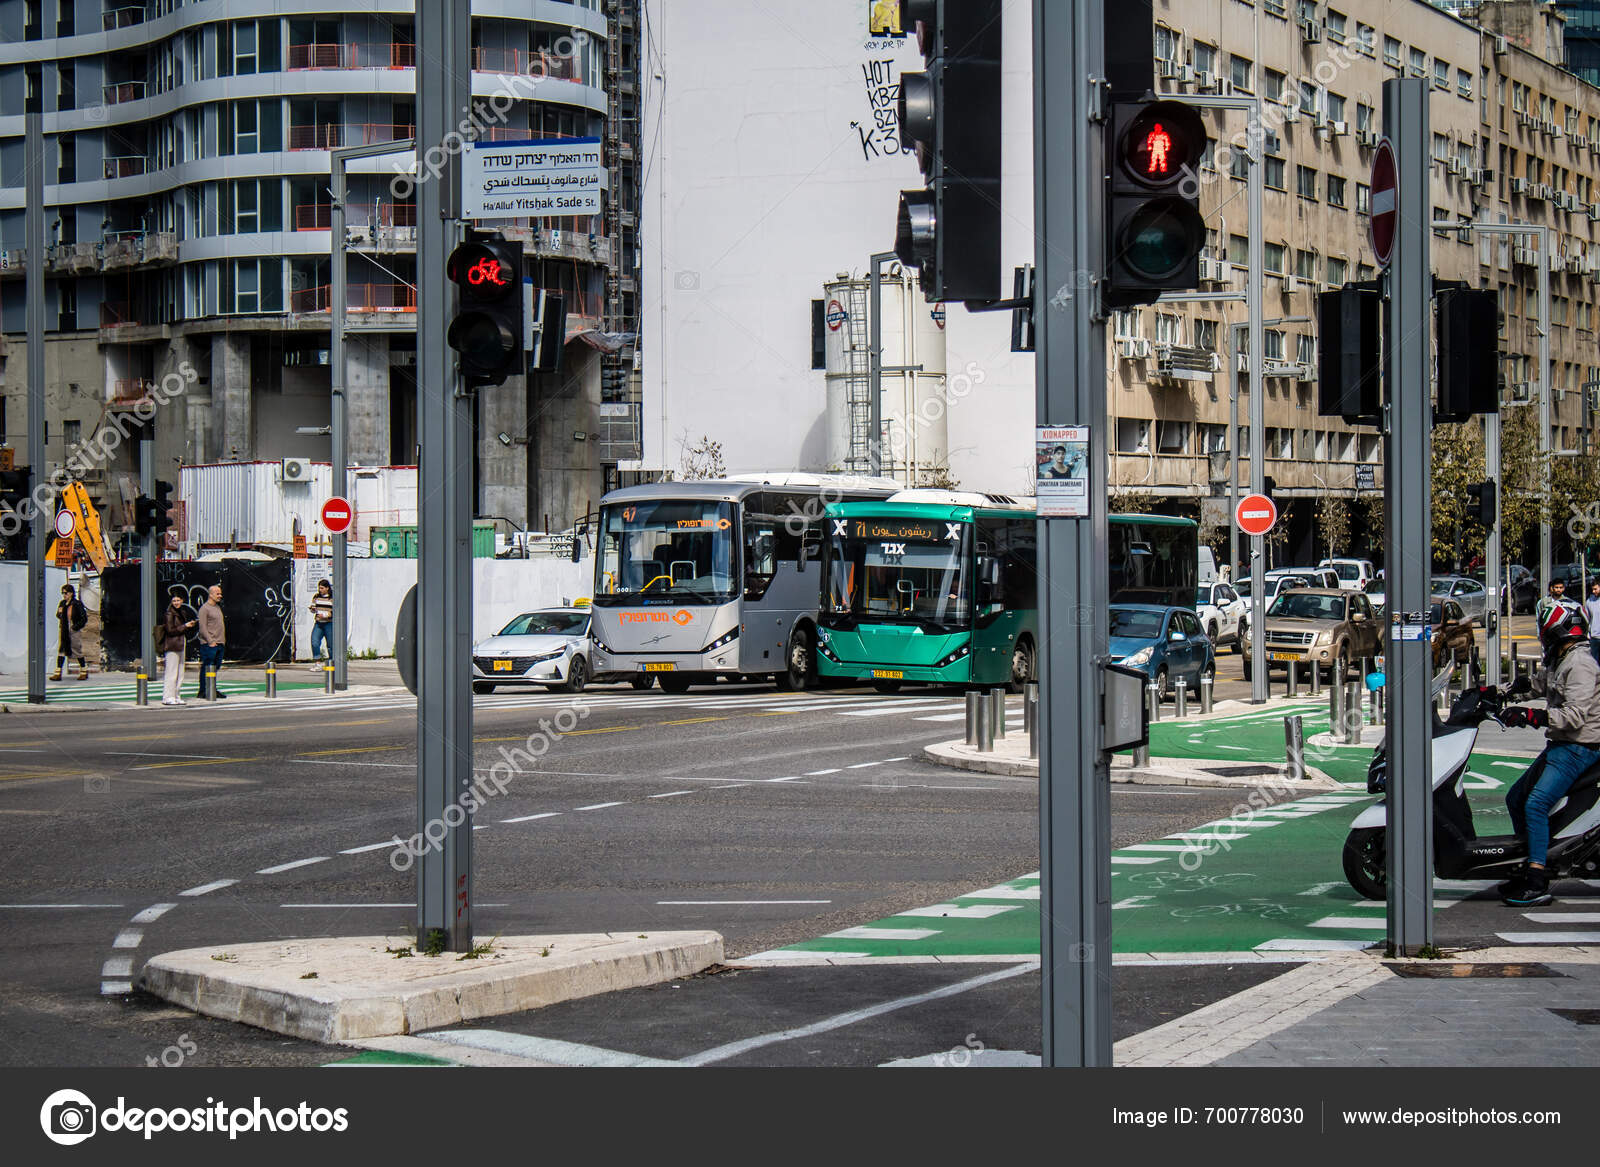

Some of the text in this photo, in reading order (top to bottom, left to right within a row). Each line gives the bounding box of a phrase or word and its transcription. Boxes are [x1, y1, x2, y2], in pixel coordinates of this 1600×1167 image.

[862, 59, 894, 88] HOT
[868, 84, 900, 109] KBZ
[483, 155, 512, 167] שדה
[515, 153, 547, 168] יצחק
[549, 153, 580, 167] האלוף
[580, 174, 599, 187] شارع
[483, 201, 513, 211] Ha'Alluf
[556, 196, 582, 208] Sade
[585, 198, 597, 207] St.
[1042, 430, 1078, 439] KIDNAPPED
[855, 521, 867, 537] 71
[618, 612, 669, 626] מטרופולין
